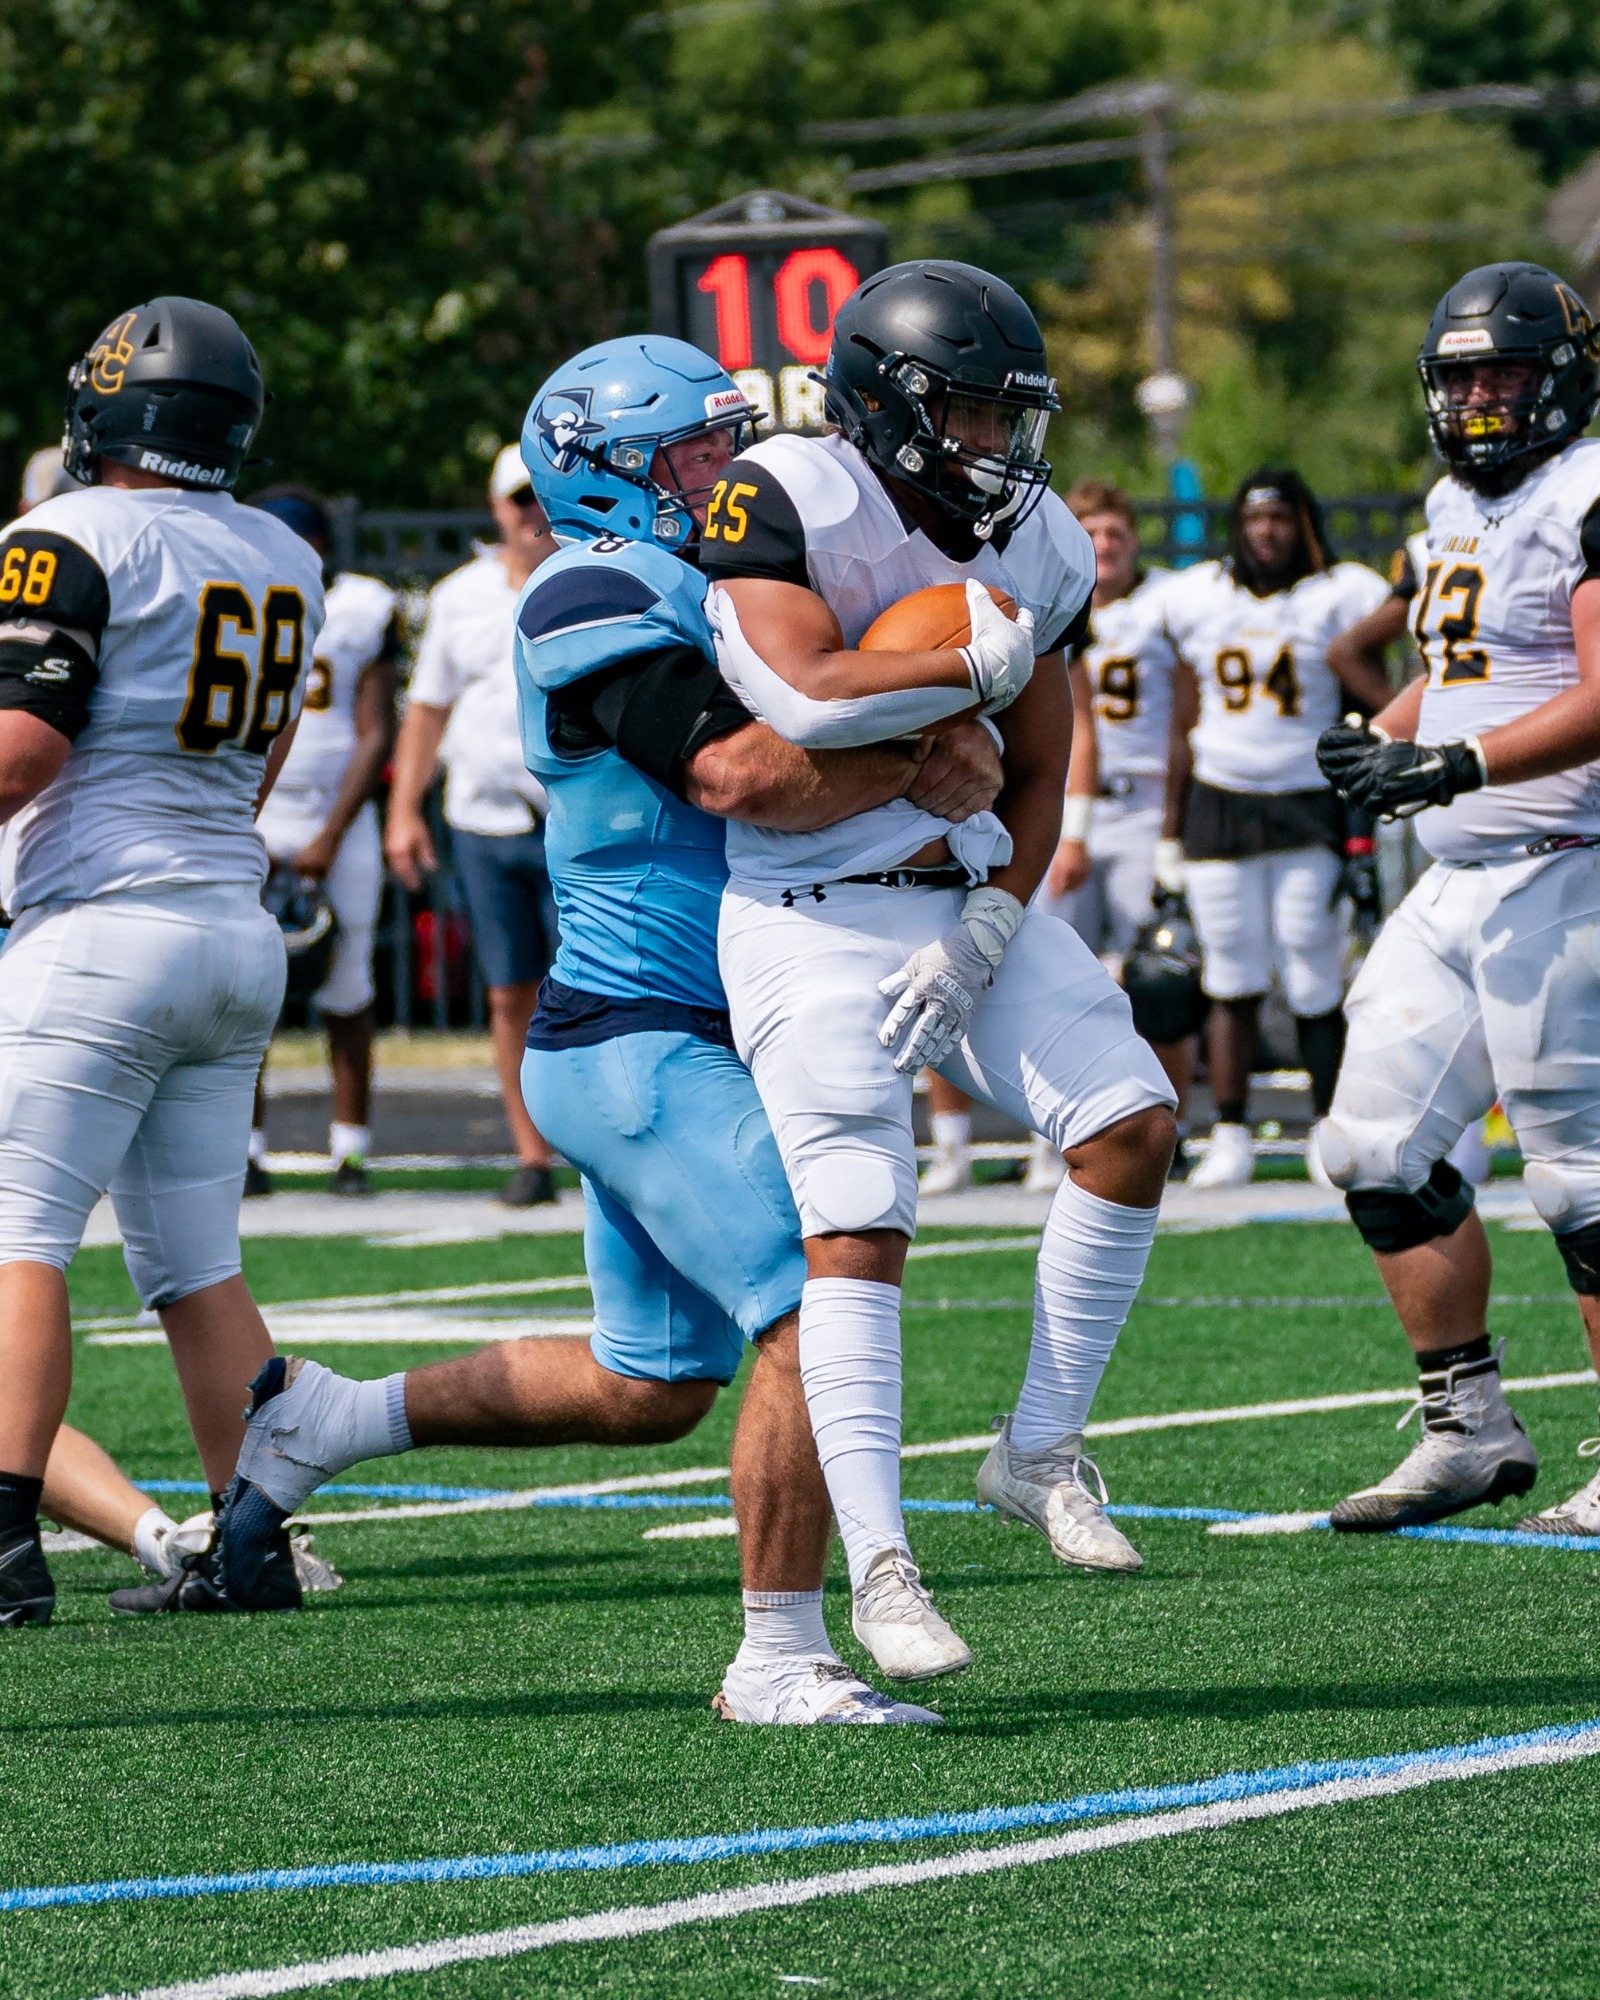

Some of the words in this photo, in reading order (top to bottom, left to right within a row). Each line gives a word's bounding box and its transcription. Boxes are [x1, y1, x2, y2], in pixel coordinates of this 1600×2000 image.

[698, 248, 860, 370] 10
[714, 392, 745, 407] Riddell
[1015, 372, 1048, 387] Riddell
[139, 451, 225, 484] Riddell
[704, 480, 759, 543] 25
[0, 547, 57, 606] 68
[1415, 560, 1491, 689] 12
[174, 579, 307, 756] 68
[1214, 646, 1301, 719] 94
